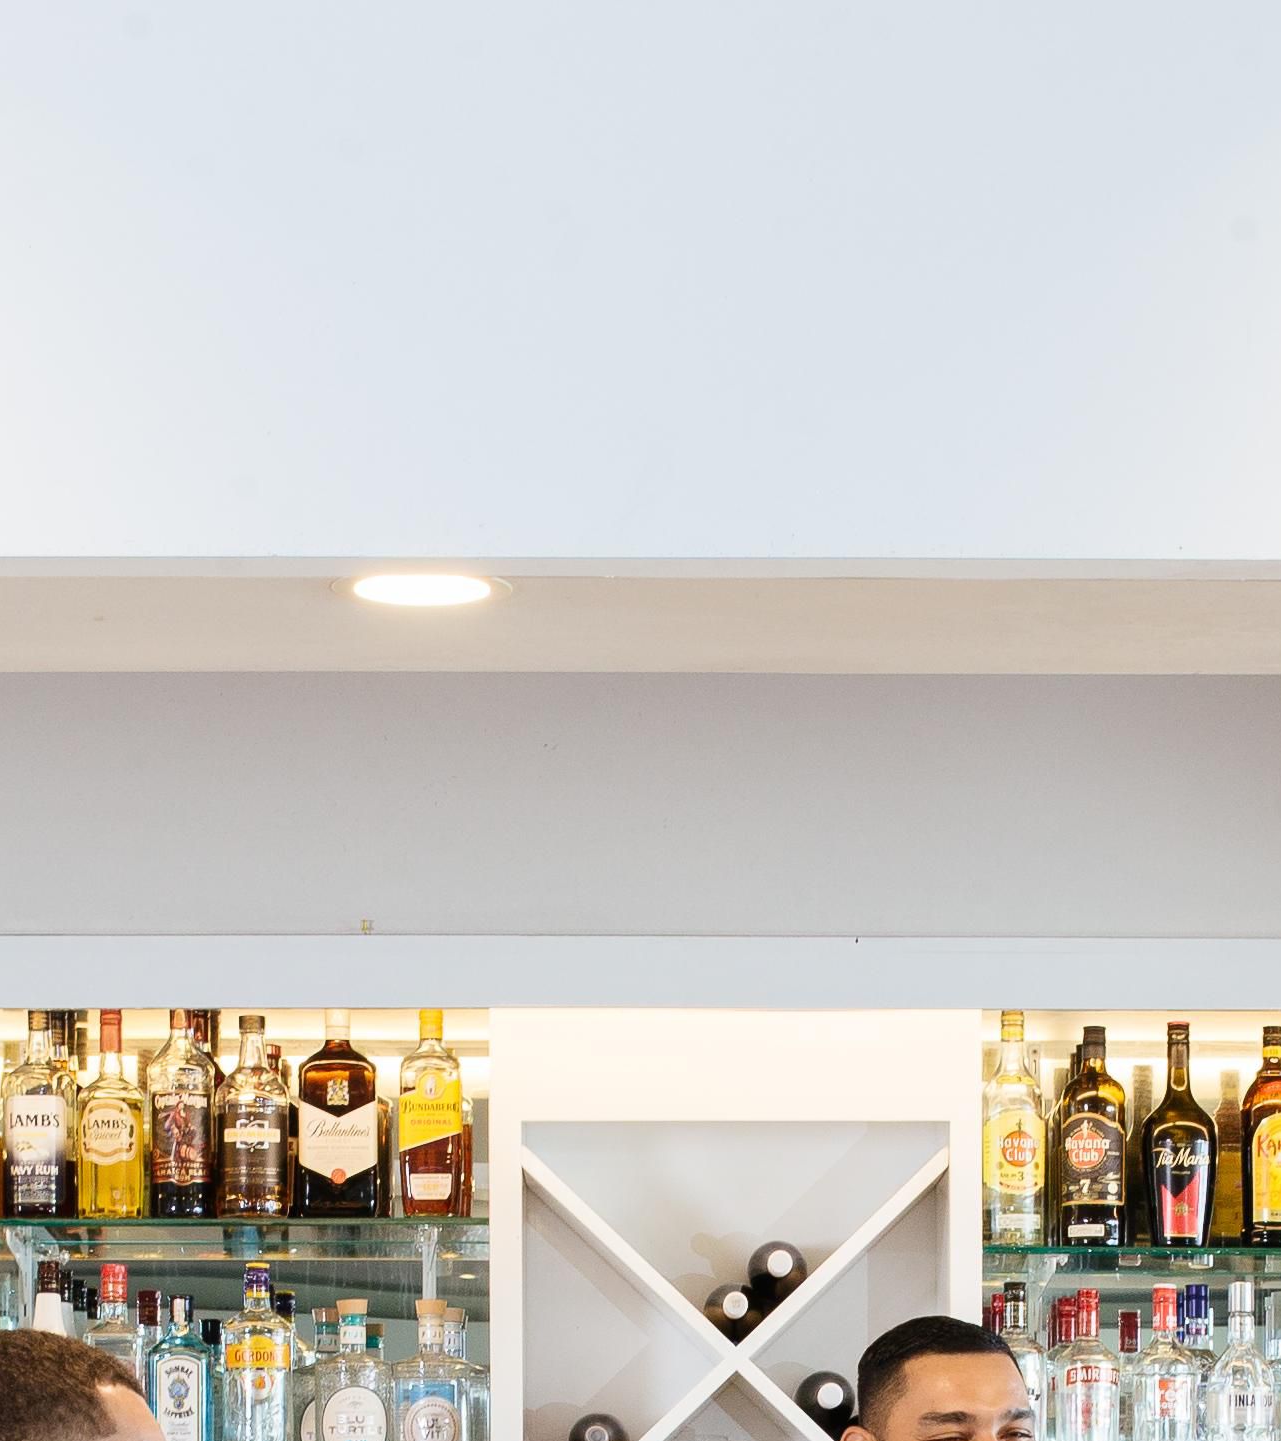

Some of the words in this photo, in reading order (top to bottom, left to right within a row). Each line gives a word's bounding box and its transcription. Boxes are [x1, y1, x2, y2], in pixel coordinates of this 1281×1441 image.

[402, 1102, 459, 1114] BUNDABERG
[10, 1112, 60, 1129] LAMB'S
[87, 1119, 128, 1129] LAMB'S
[307, 1118, 371, 1138] Ballantine's
[998, 1137, 1039, 1149] Havana
[1065, 1137, 1110, 1149] Havana
[1006, 1149, 1032, 1162] Club
[1072, 1149, 1099, 1163] Club
[1153, 1147, 1174, 1168] Tia
[1174, 1147, 1210, 1168] Maria
[1018, 1171, 1024, 1181] 3
[1080, 1179, 1090, 1193] 7
[164, 1365, 194, 1379] BOMBAY
[164, 1407, 195, 1419] SAPPHIRE
[336, 1415, 375, 1425] BLUE
[328, 1426, 383, 1435] TURTLE
